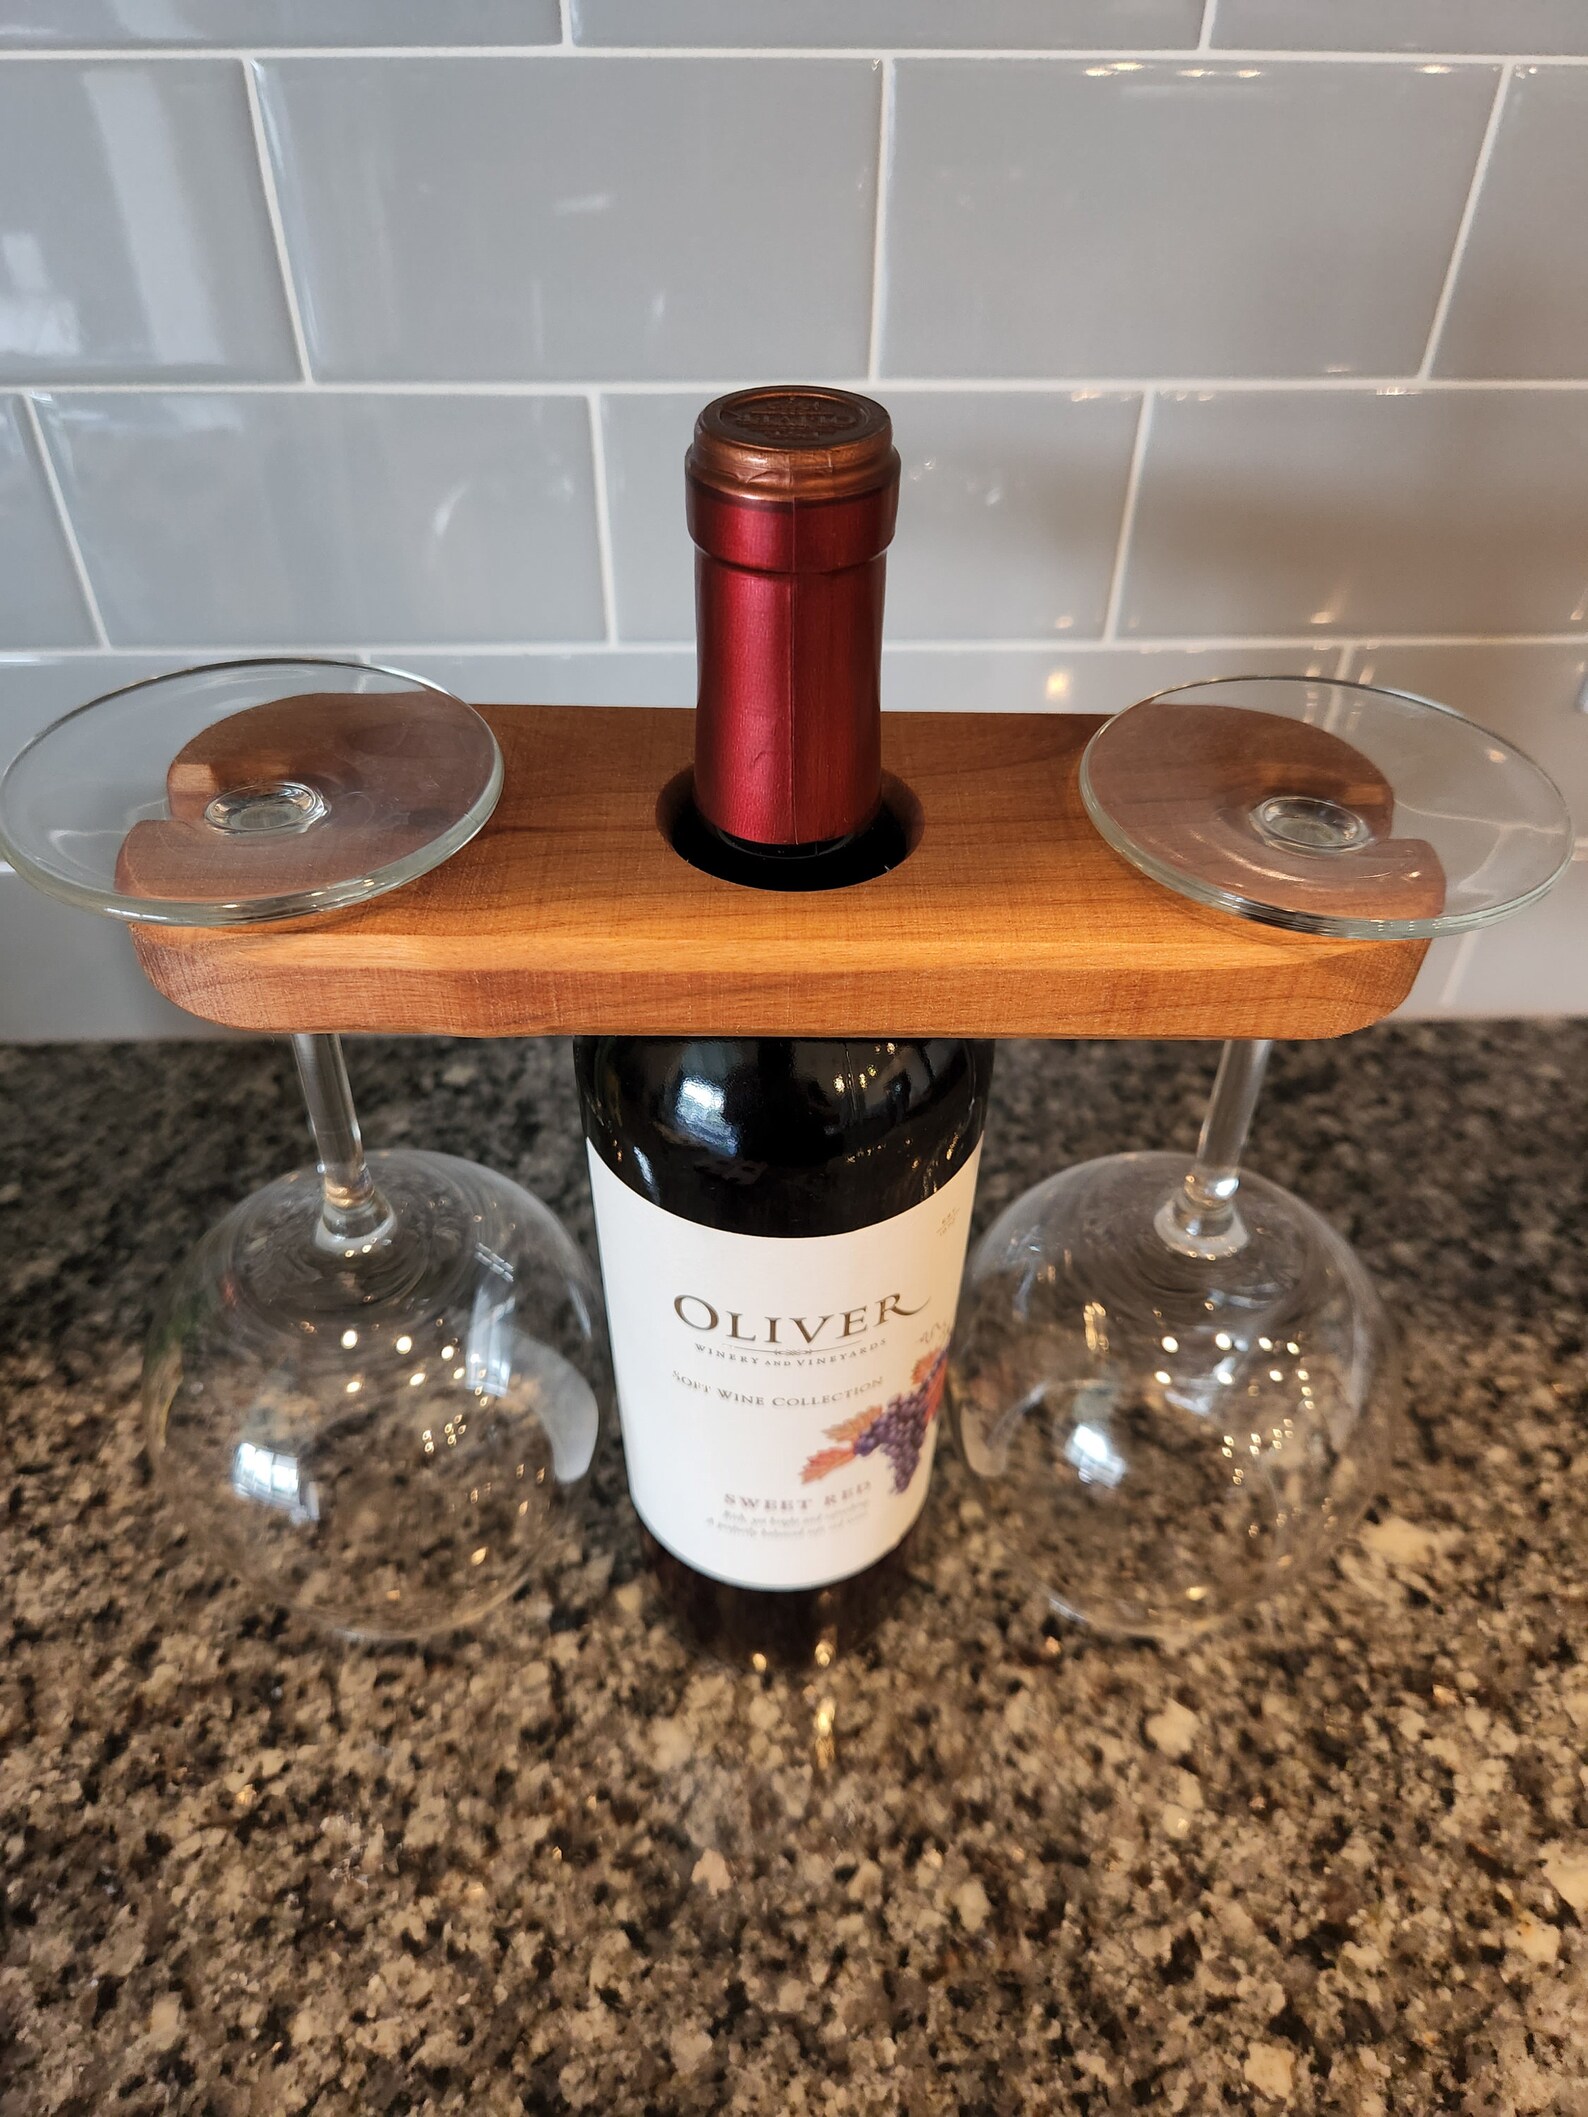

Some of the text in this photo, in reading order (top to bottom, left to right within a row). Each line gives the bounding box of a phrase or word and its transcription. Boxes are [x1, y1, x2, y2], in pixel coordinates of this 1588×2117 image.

[673, 1292, 931, 1344] OLIVER
[694, 1342, 760, 1365] WINERY
[796, 1337, 887, 1366] VINEYARDS
[671, 1369, 884, 1408] SOFT WINE COLLECTION
[724, 1492, 813, 1511] SWEET
[824, 1481, 872, 1507] RED
